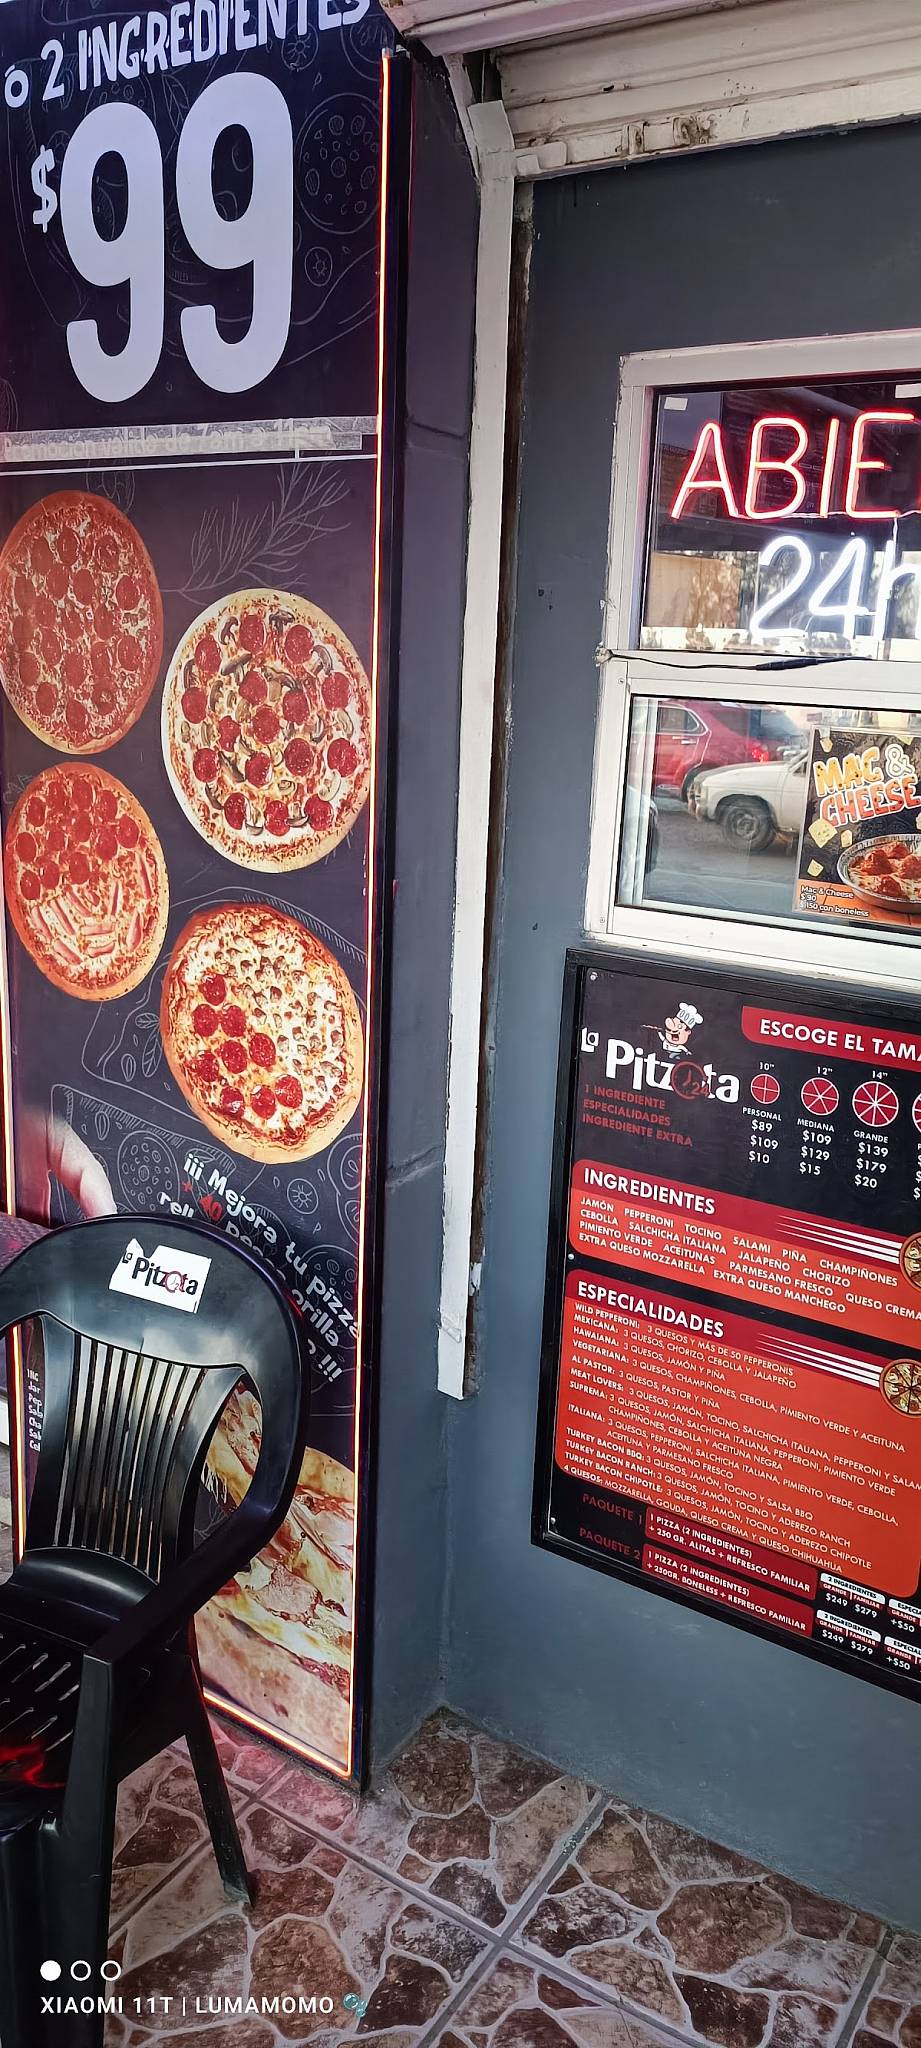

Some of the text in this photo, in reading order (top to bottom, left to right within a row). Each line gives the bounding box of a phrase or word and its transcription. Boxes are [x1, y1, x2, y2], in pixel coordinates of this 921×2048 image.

[40, 39, 64, 100] 2
[80, 0, 369, 90] INGREDIENTES
[671, 412, 921, 519] ABIE
[751, 536, 921, 640] 24h
[813, 744, 915, 798] MAC &
[820, 774, 921, 827] CHEESE
[801, 885, 817, 894] Mac
[835, 906, 869, 917] boneless
[581, 1028, 599, 1053] La
[760, 1019, 838, 1046] ESCOGE
[844, 1034, 864, 1052] EL
[584, 1100, 670, 1126] ESPECIALIDADES
[594, 1086, 665, 1109] INGREDIENTE
[583, 1114, 693, 1146] INGREDIENTE EXTRA
[743, 1107, 888, 1143] PERSONAL MEDIANA GRANDE
[751, 1119, 888, 1157] $89 $109 $139
[749, 1151, 878, 1188] $10 $15 $20
[751, 1135, 886, 1173] $109 $129 $179
[584, 1168, 715, 1214] INGREDIENTES
[208, 1169, 278, 1244] Mejora
[286, 1242, 307, 1275] tu
[580, 1197, 897, 1287] JAMÓN PEPPERONI TOCINO SALAMI PIÑA CHAMPIÑONES
[580, 1209, 850, 1287] CEBOLLA SALCHICHA ITALIANA JALAPEÑO CHORIZO
[580, 1221, 621, 1238] PIMIENTO
[624, 1233, 653, 1247] VERDE
[663, 1244, 716, 1265] ACEITUNAS
[729, 1261, 791, 1285] PARMESANO
[795, 1280, 833, 1296] FRESCO
[845, 1293, 882, 1309] QUESO
[579, 1233, 846, 1313] EXTRA QUESO MOZZARELLA EXTRA QUESO MANCHEGO
[578, 1281, 724, 1338] ESPECIALIDADES
[573, 1326, 619, 1346] HAWAIANA:
[631, 1345, 664, 1361] QUESOS,
[667, 1357, 696, 1371] JAMÓN
[707, 1369, 725, 1381] PIÑA
[574, 1314, 619, 1333] MEXICANA:
[631, 1332, 664, 1348] QUESOS,
[667, 1343, 704, 1361] CHORIZO,
[708, 1356, 743, 1372] CEBOLLA
[753, 1369, 797, 1389] JALAPEÑO
[575, 1303, 594, 1315] WILD
[595, 1310, 640, 1328] PEPPERONI:
[655, 1327, 688, 1344] QUESOS
[697, 1341, 715, 1353] MÁS
[718, 1348, 729, 1357] DE
[731, 1351, 741, 1360] 50
[744, 1352, 793, 1376] PEPPERONIS
[572, 1355, 582, 1364] AL
[583, 1358, 615, 1374] PASTOR:
[626, 1372, 660, 1390] QUESOS,
[662, 1385, 691, 1399] PASTOR
[701, 1397, 721, 1409] PIÑA
[567, 1427, 595, 1442] TURKEY
[597, 1438, 624, 1454] BACON
[646, 1455, 651, 1463] 3
[654, 1459, 687, 1476] QUESOS,
[690, 1472, 721, 1489] JAMÓN,
[724, 1483, 756, 1500] TOCINO
[767, 1499, 792, 1513] SALSA
[795, 1508, 814, 1520] BBQ
[571, 1467, 603, 1484] QUESOS:
[605, 1479, 653, 1504] MOZZARELLA,
[656, 1498, 687, 1517] GOUDA,
[690, 1511, 718, 1527] QUESO
[721, 1523, 748, 1537] CREMA
[759, 1537, 789, 1552] QUESO
[791, 1548, 842, 1573] CHIHUAHUA
[583, 1493, 633, 1520] PAQUETE
[657, 1516, 679, 1531] PIZZA
[692, 1530, 752, 1558] INGREDIENTES)
[657, 1528, 671, 1538] 250
[673, 1534, 686, 1545] GR.
[689, 1541, 716, 1556] ALITAS
[727, 1555, 768, 1576] REFRESCO
[771, 1571, 811, 1592] FAMILIAR
[823, 1584, 880, 1609] GRANDE FAMILIAR
[826, 1593, 877, 1618] $249 $279
[834, 1578, 877, 1599] INGREDIENTES
[892, 1610, 916, 1622] GRANDE
